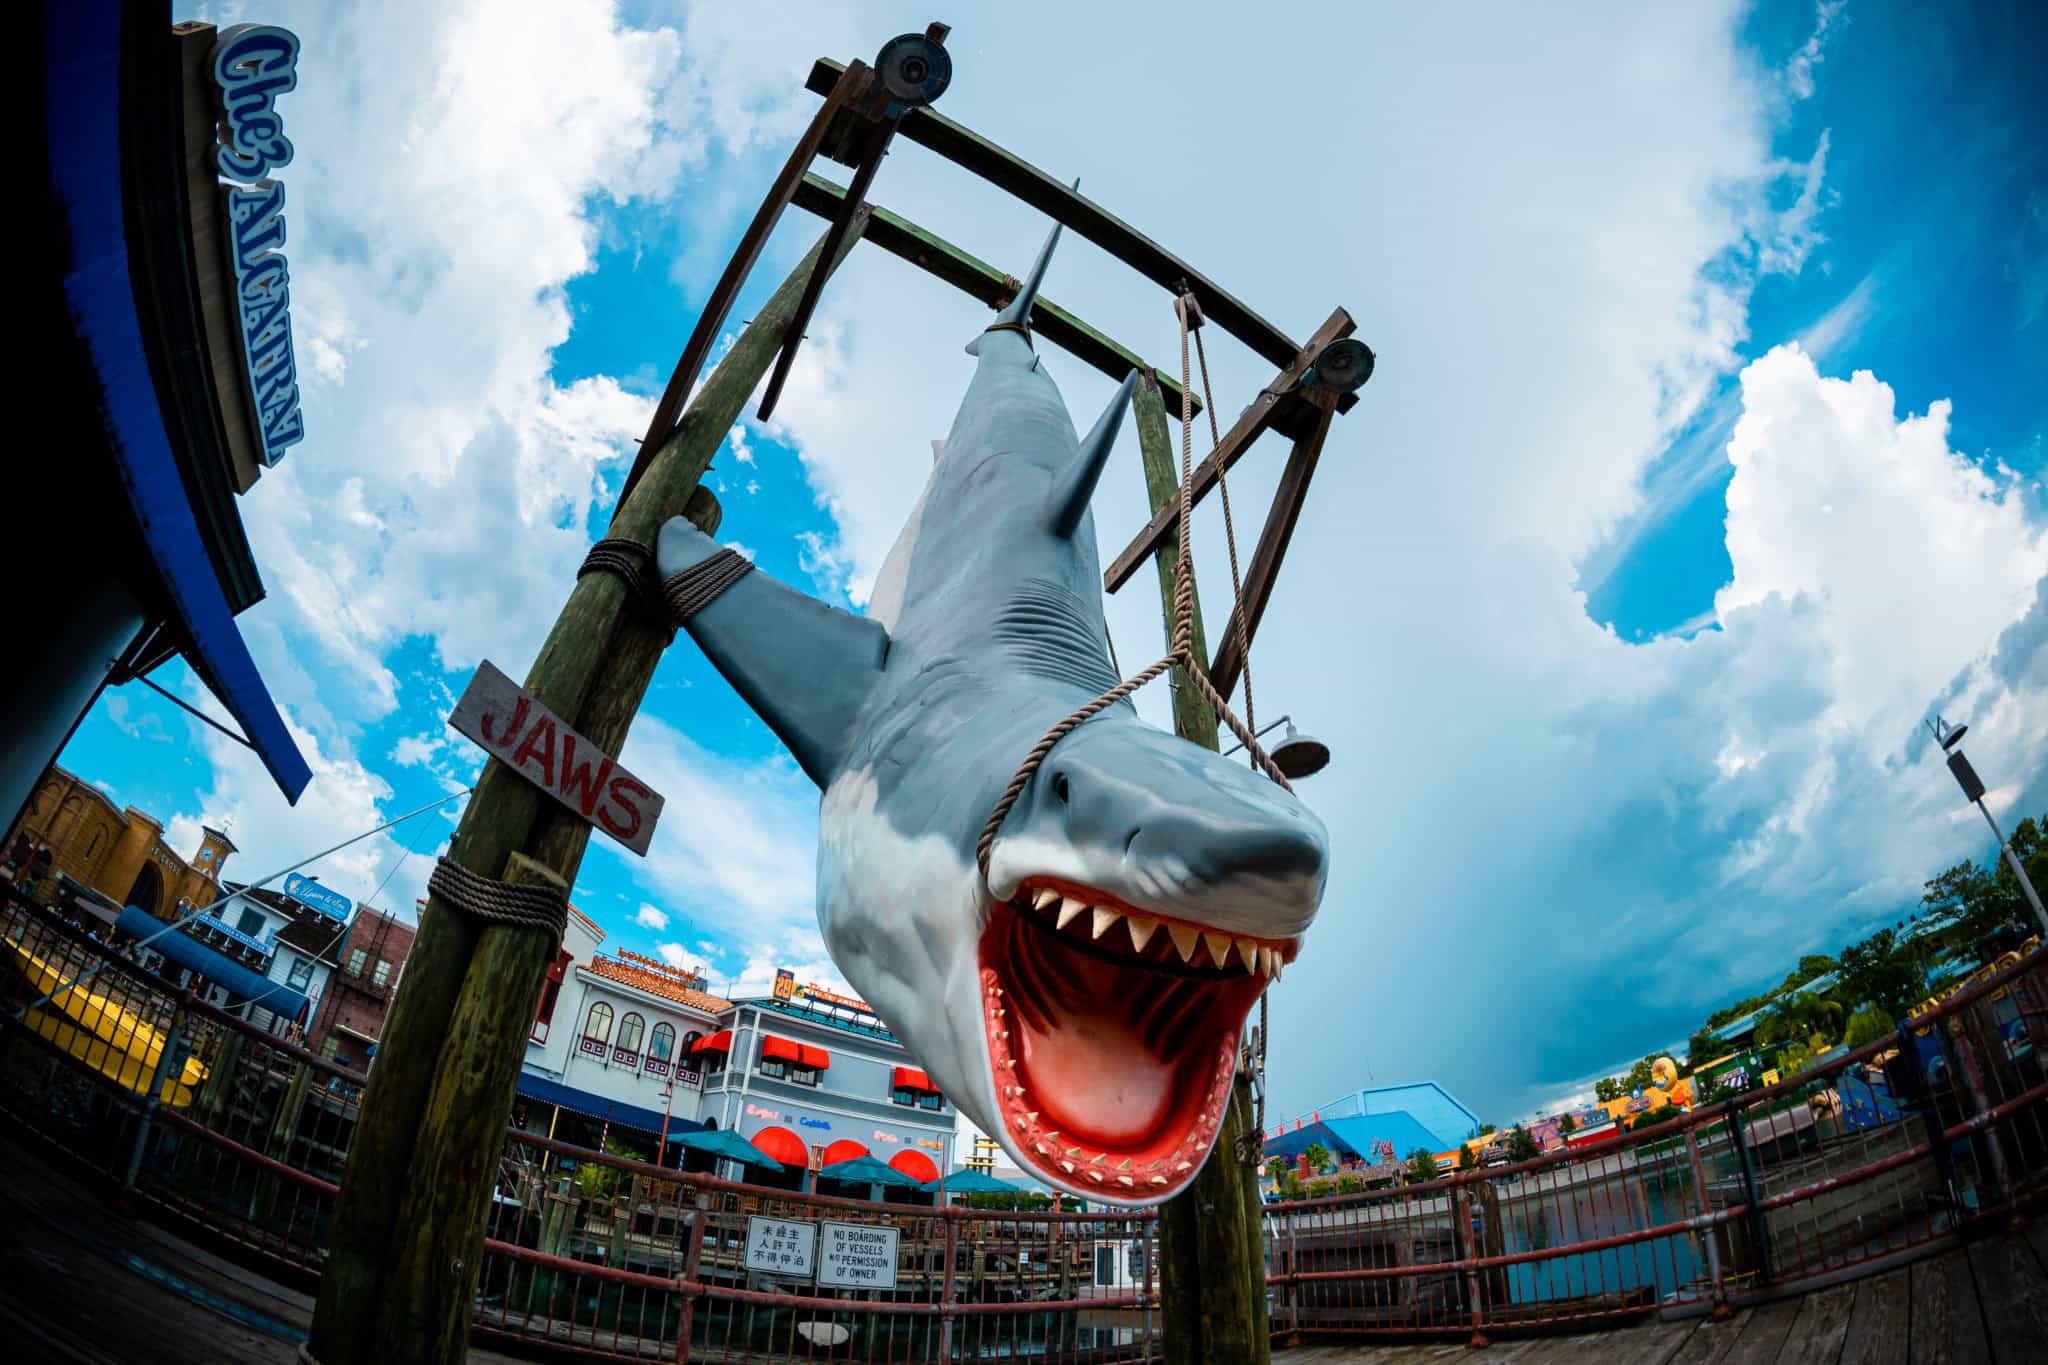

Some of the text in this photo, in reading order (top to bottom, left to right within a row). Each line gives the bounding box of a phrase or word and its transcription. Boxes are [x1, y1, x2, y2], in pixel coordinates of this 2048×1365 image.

[219, 32, 302, 465] Chez ALCATRAZ
[480, 695, 650, 841] JAWS
[833, 1229, 888, 1245] NO BOARDING
[835, 1241, 884, 1256] OF VESSELS
[841, 1255, 889, 1269] PERMISSION
[836, 1266, 877, 1281] OF OWNER
